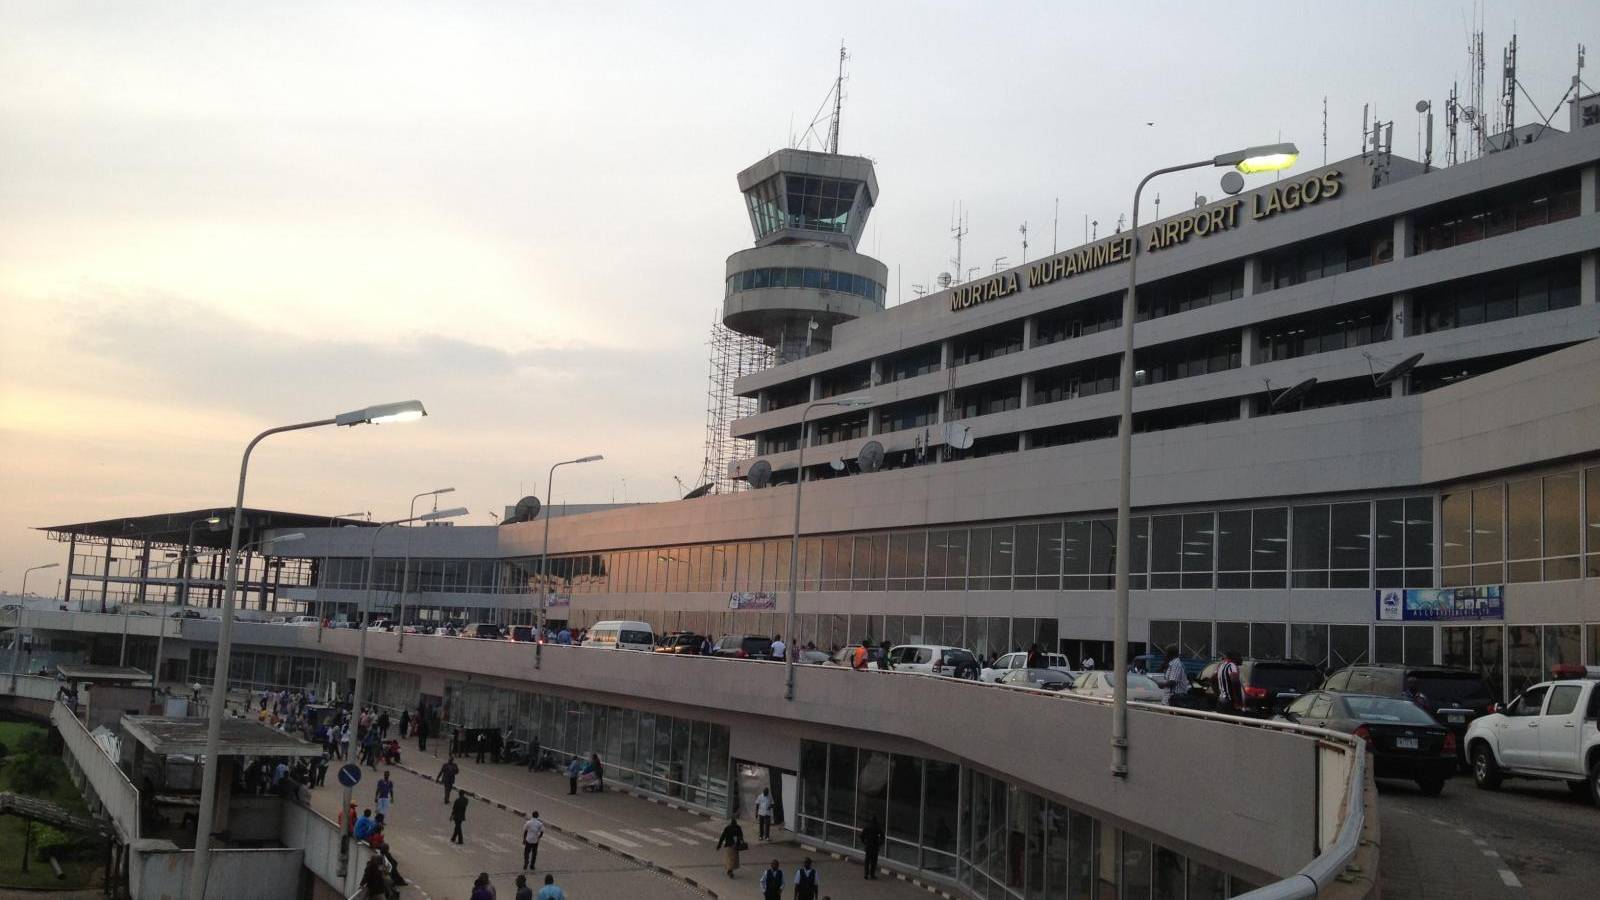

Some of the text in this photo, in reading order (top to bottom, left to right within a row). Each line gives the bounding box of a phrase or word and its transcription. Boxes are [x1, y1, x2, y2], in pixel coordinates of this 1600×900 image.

[950, 170, 1340, 311] MURTALA MUHAMMED AIRPORT LAGOS
